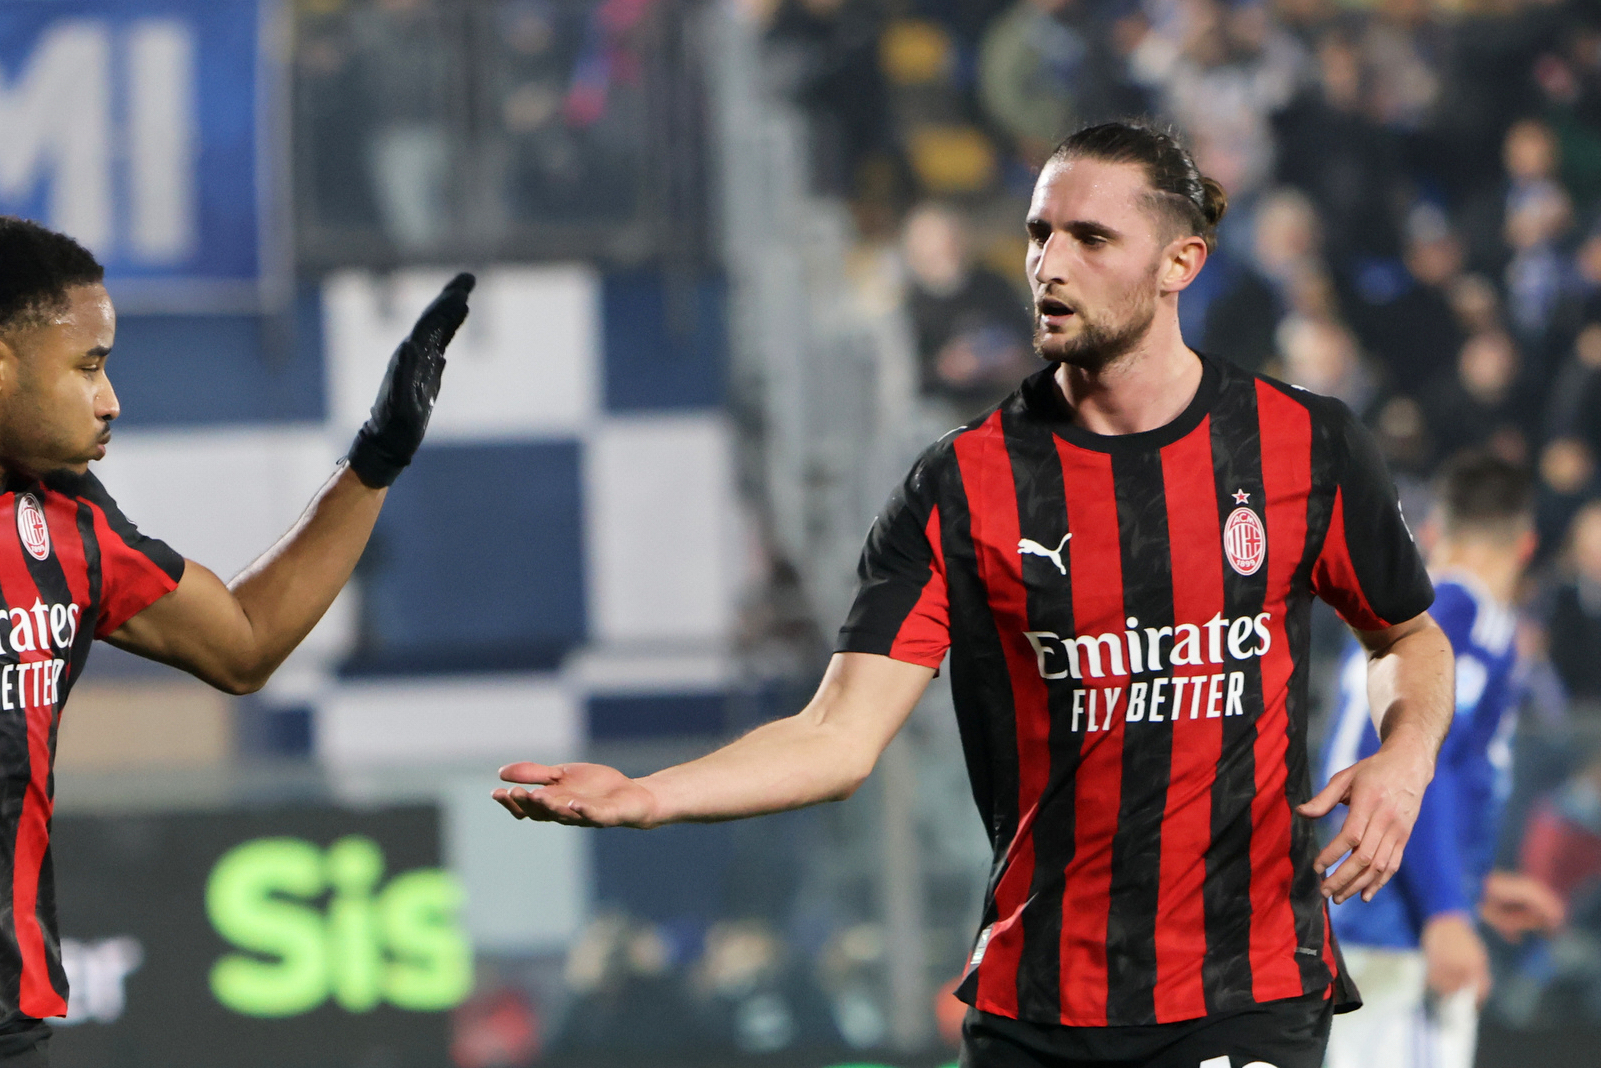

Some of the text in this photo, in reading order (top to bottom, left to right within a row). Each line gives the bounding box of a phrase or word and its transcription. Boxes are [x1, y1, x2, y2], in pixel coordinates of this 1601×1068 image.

[1232, 512, 1255, 526] ACM
[1022, 611, 1271, 679] Emirates
[1071, 671, 1245, 732] FLY BETTER
